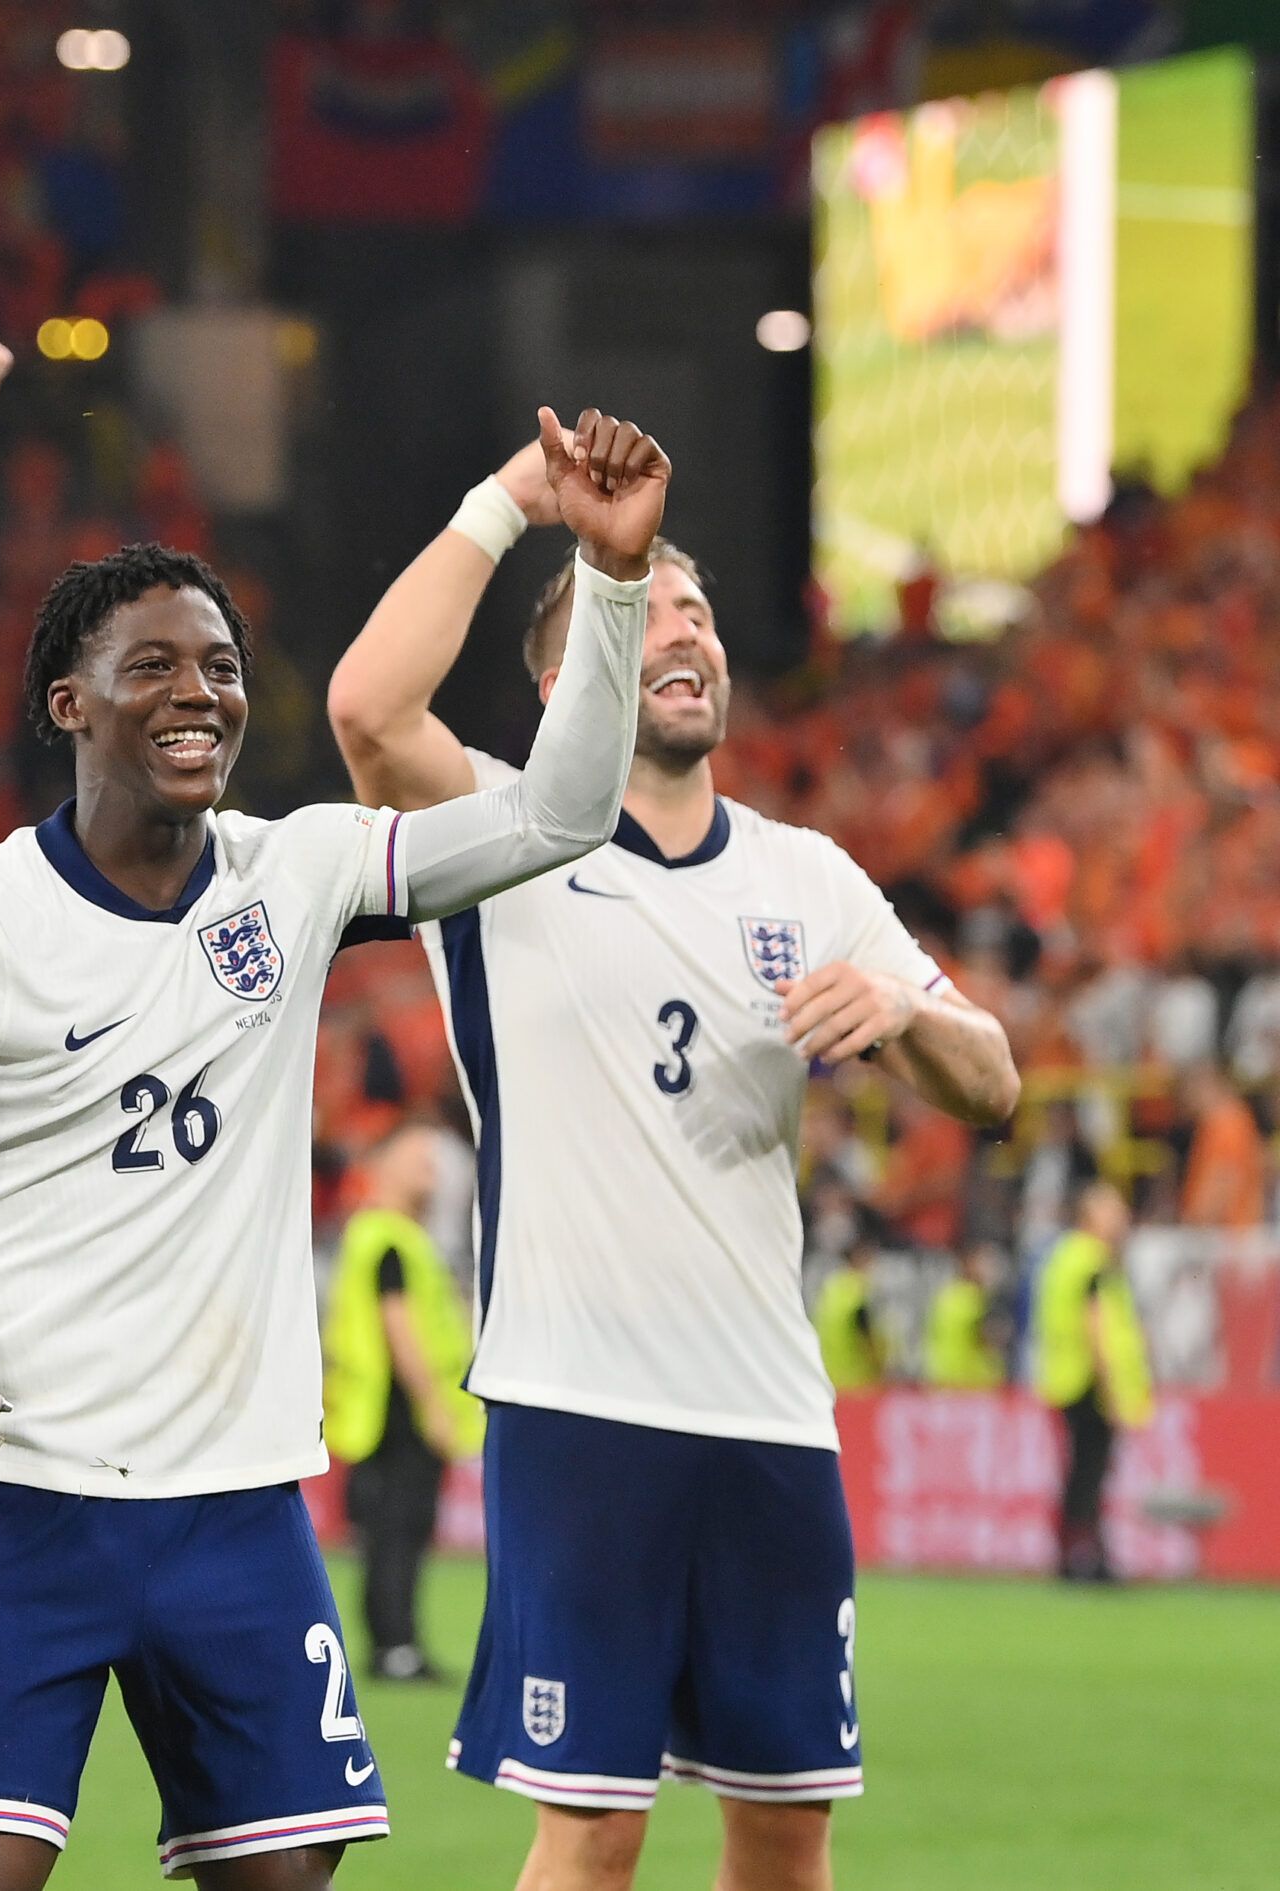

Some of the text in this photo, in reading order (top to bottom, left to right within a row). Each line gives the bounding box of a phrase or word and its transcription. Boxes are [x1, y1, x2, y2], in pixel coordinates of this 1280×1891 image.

[653, 999, 699, 1101] 3
[112, 1059, 222, 1174] 26
[304, 1622, 366, 1743] 2
